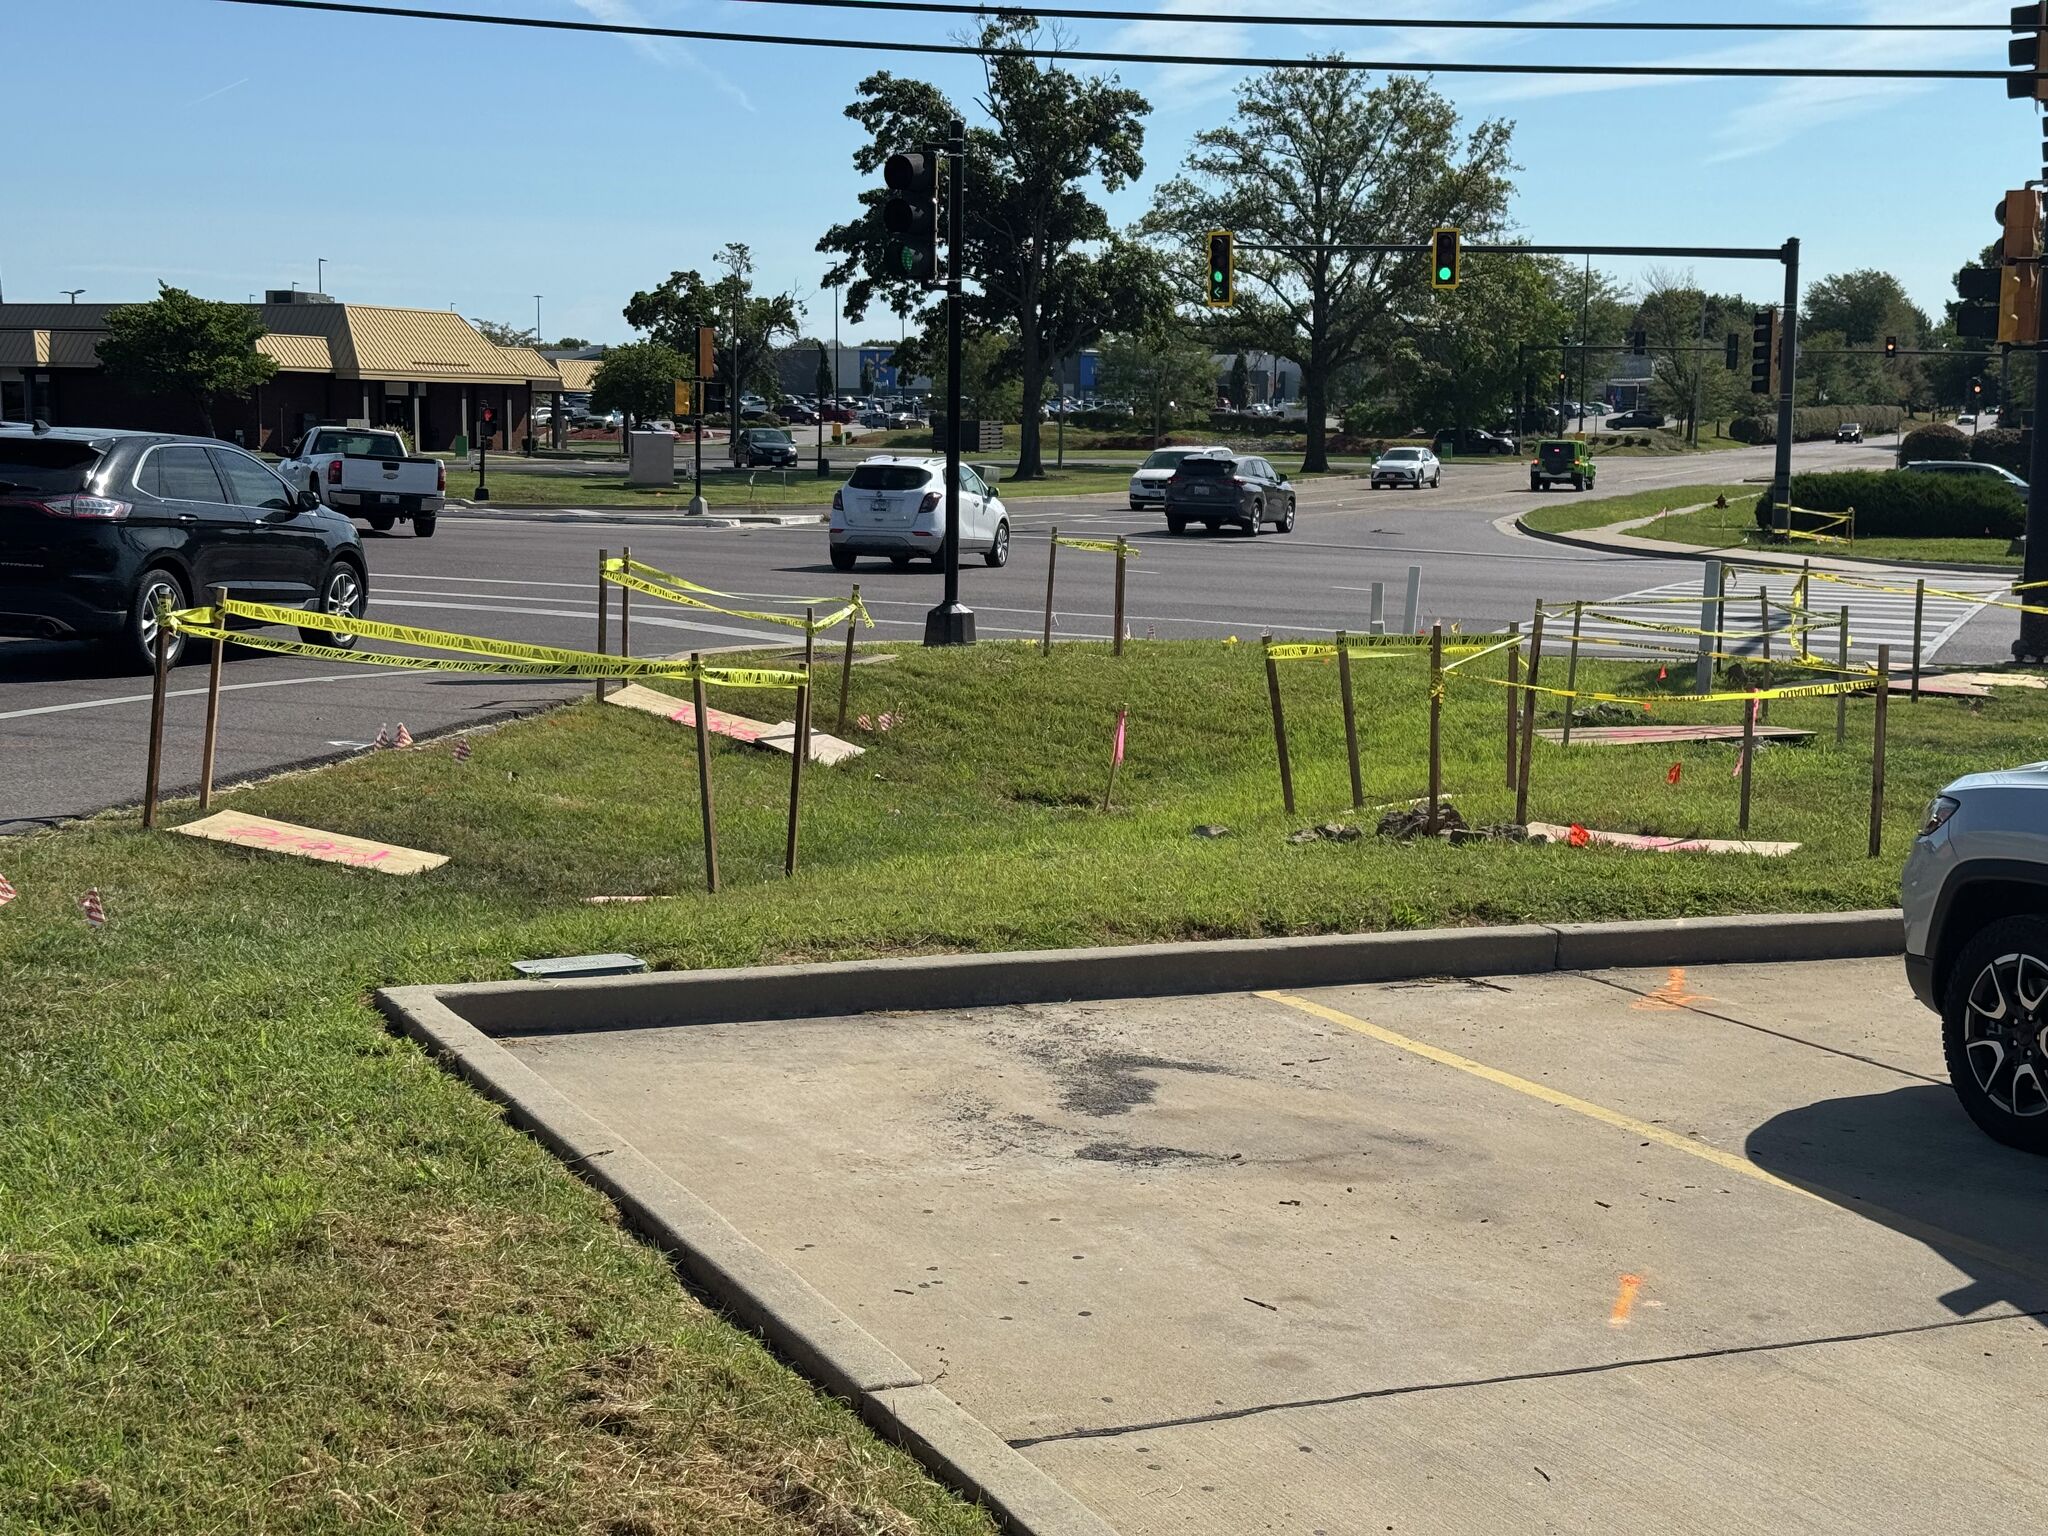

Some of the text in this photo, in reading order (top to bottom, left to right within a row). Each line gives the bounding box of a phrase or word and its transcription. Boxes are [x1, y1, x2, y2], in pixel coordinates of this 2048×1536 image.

[1441, 635, 1463, 646] UTION
[300, 645, 345, 660] CAUTION
[368, 654, 416, 667] CUIDADO
[436, 660, 485, 673] CAUTION
[506, 663, 554, 674] CUIDADO
[577, 663, 623, 675] CAUTION
[1778, 684, 1824, 699] CUIDADO
